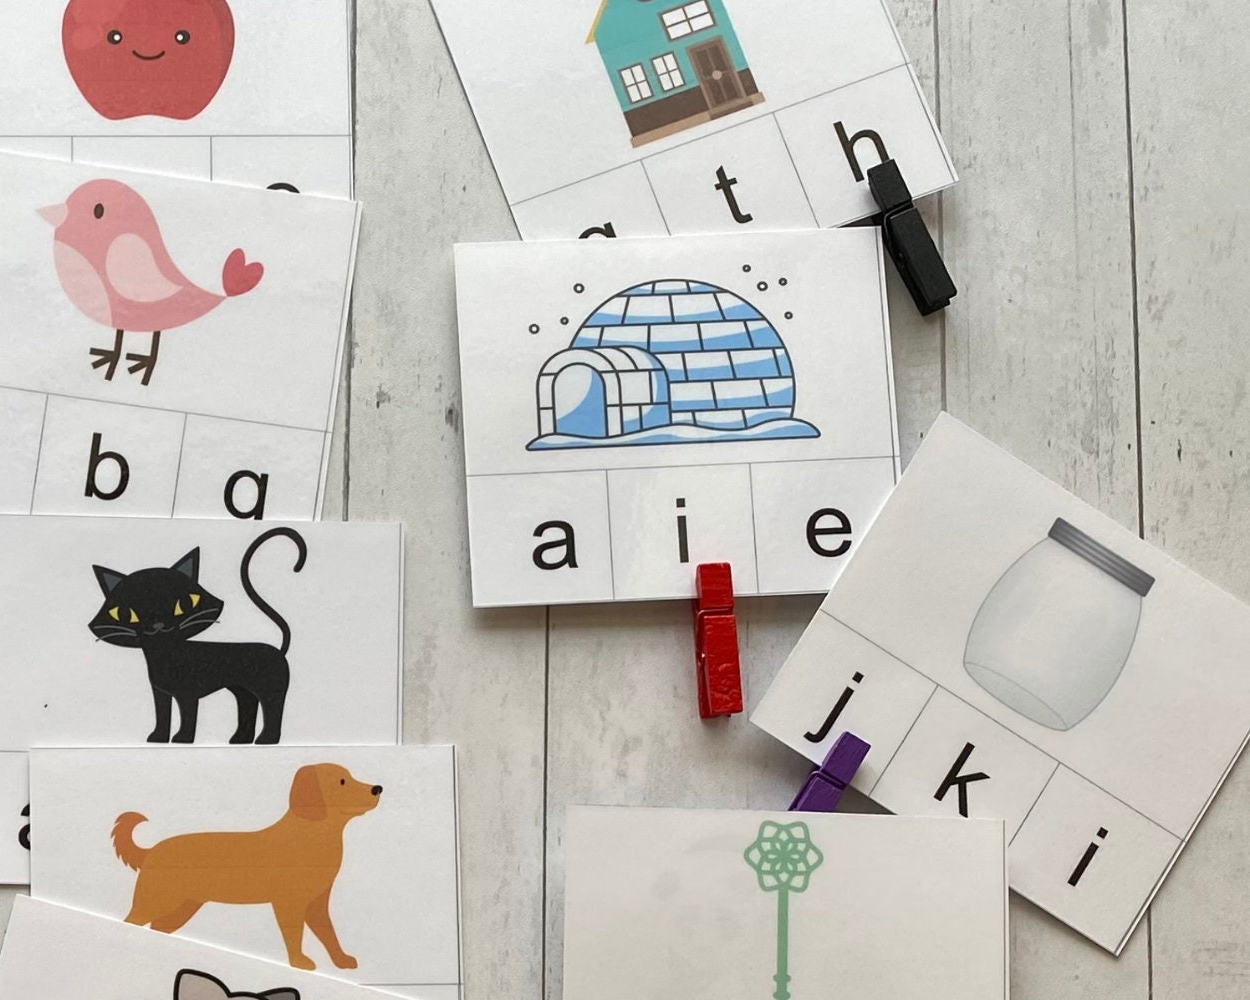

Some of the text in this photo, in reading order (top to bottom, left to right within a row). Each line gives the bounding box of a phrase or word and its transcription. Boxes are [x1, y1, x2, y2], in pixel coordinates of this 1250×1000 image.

[715, 121, 890, 223] t h
[85, 433, 129, 500] b
[533, 498, 853, 570] a i e
[803, 671, 1108, 886] j k i
